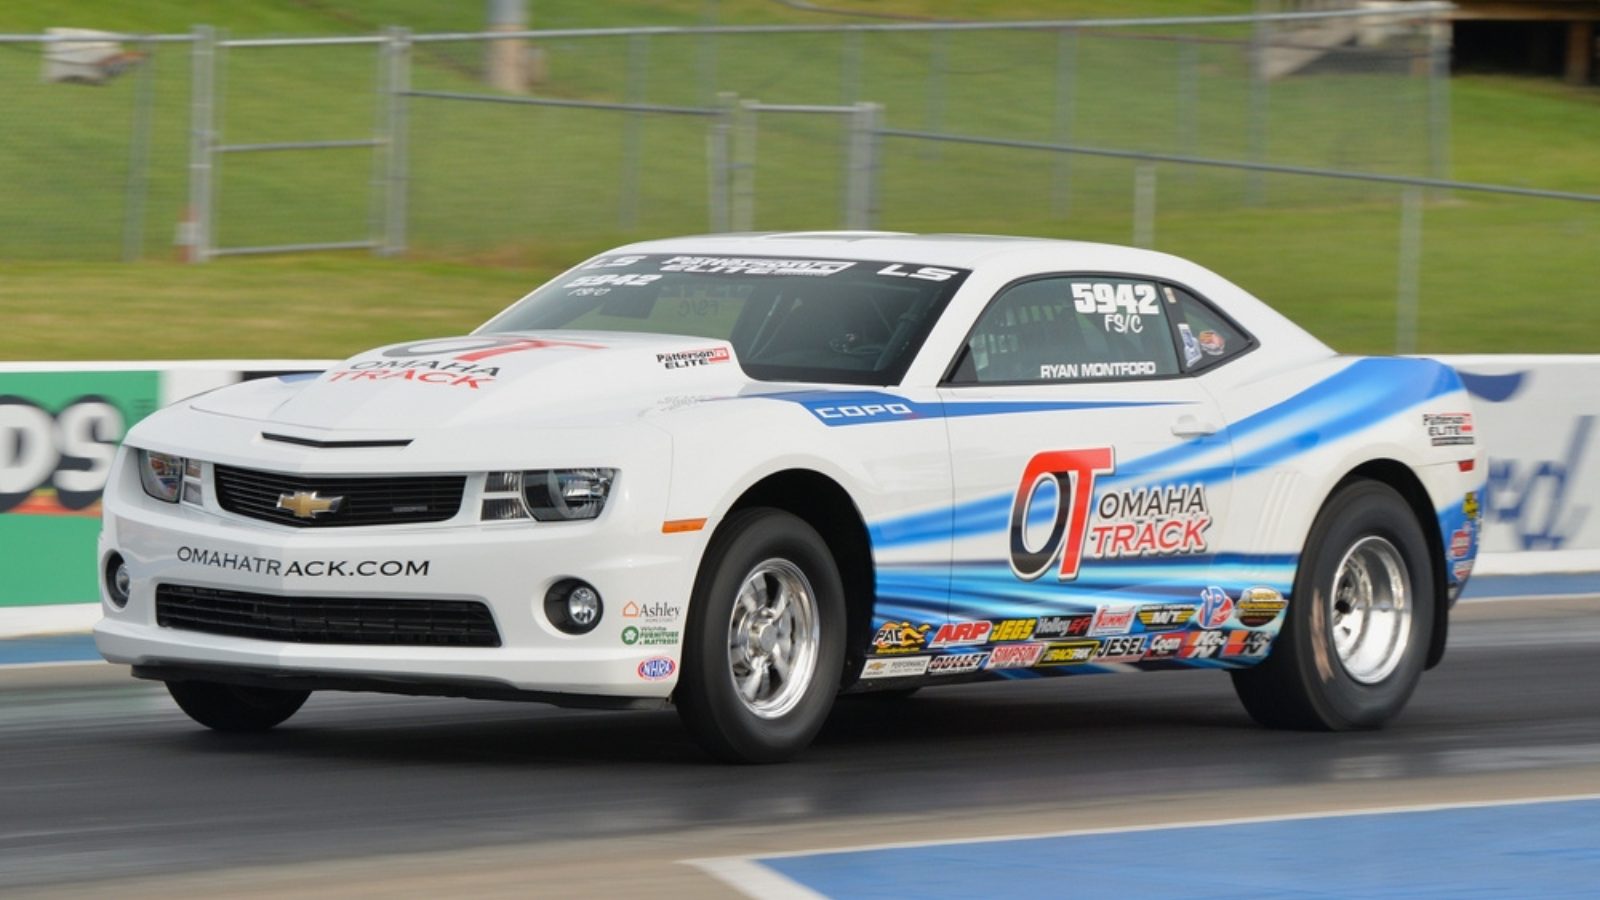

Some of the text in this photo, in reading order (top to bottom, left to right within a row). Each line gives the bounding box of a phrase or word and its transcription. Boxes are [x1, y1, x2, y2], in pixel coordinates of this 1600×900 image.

[563, 274, 663, 288] 5942
[877, 264, 959, 282] LS
[1071, 283, 1159, 315] 5942
[1105, 314, 1143, 333] FS/C
[350, 358, 500, 377] OMAHA
[664, 359, 709, 370] ELITE
[1040, 361, 1156, 379] RYAN MONTFORD
[328, 369, 497, 389] TRACK
[815, 403, 912, 419] COPO
[1099, 486, 1206, 520] OMAHA
[1091, 518, 1210, 556] TRACK
[177, 545, 431, 578] OMAHATRACK.COM
[640, 602, 681, 620] Ashley
[933, 623, 992, 644] ARP
[990, 619, 1036, 641] JEGS
[1097, 636, 1147, 658] JESEL
